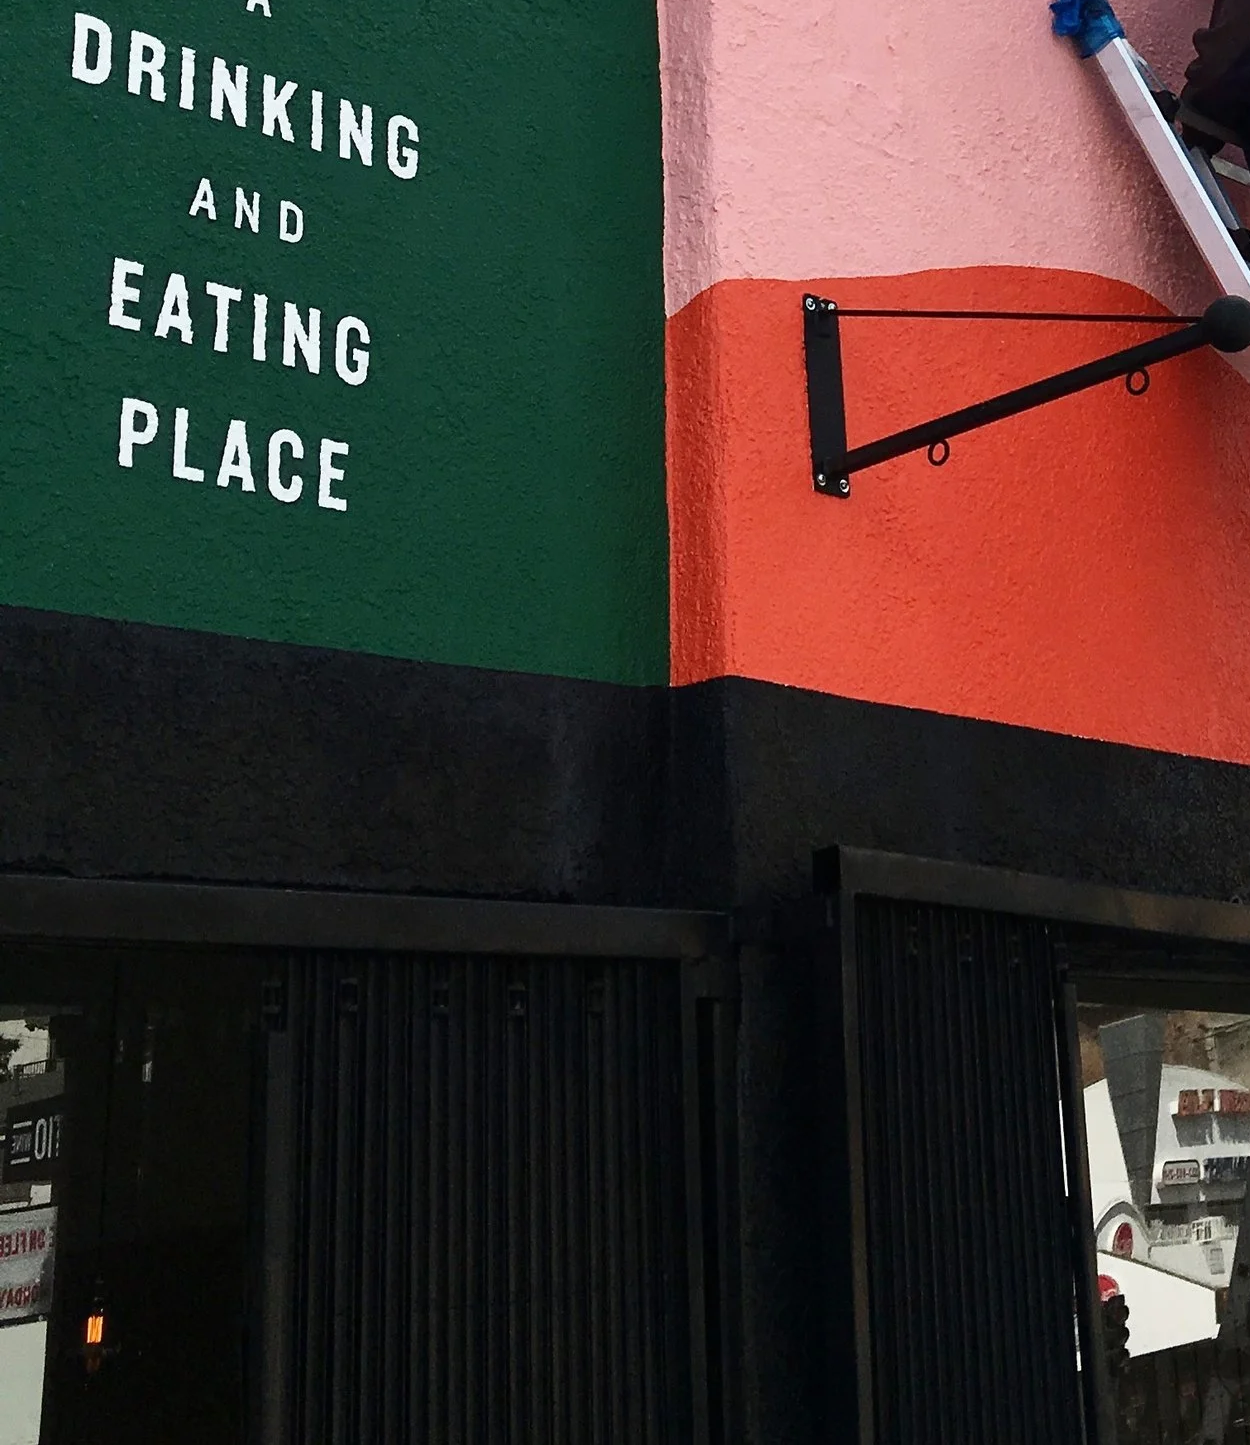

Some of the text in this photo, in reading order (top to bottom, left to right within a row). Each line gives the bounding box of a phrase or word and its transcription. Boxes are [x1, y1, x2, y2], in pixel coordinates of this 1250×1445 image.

[71, 12, 420, 180] DRINKING
[188, 177, 304, 244] AND
[108, 256, 371, 386] EATING
[118, 397, 350, 512] PLACE
